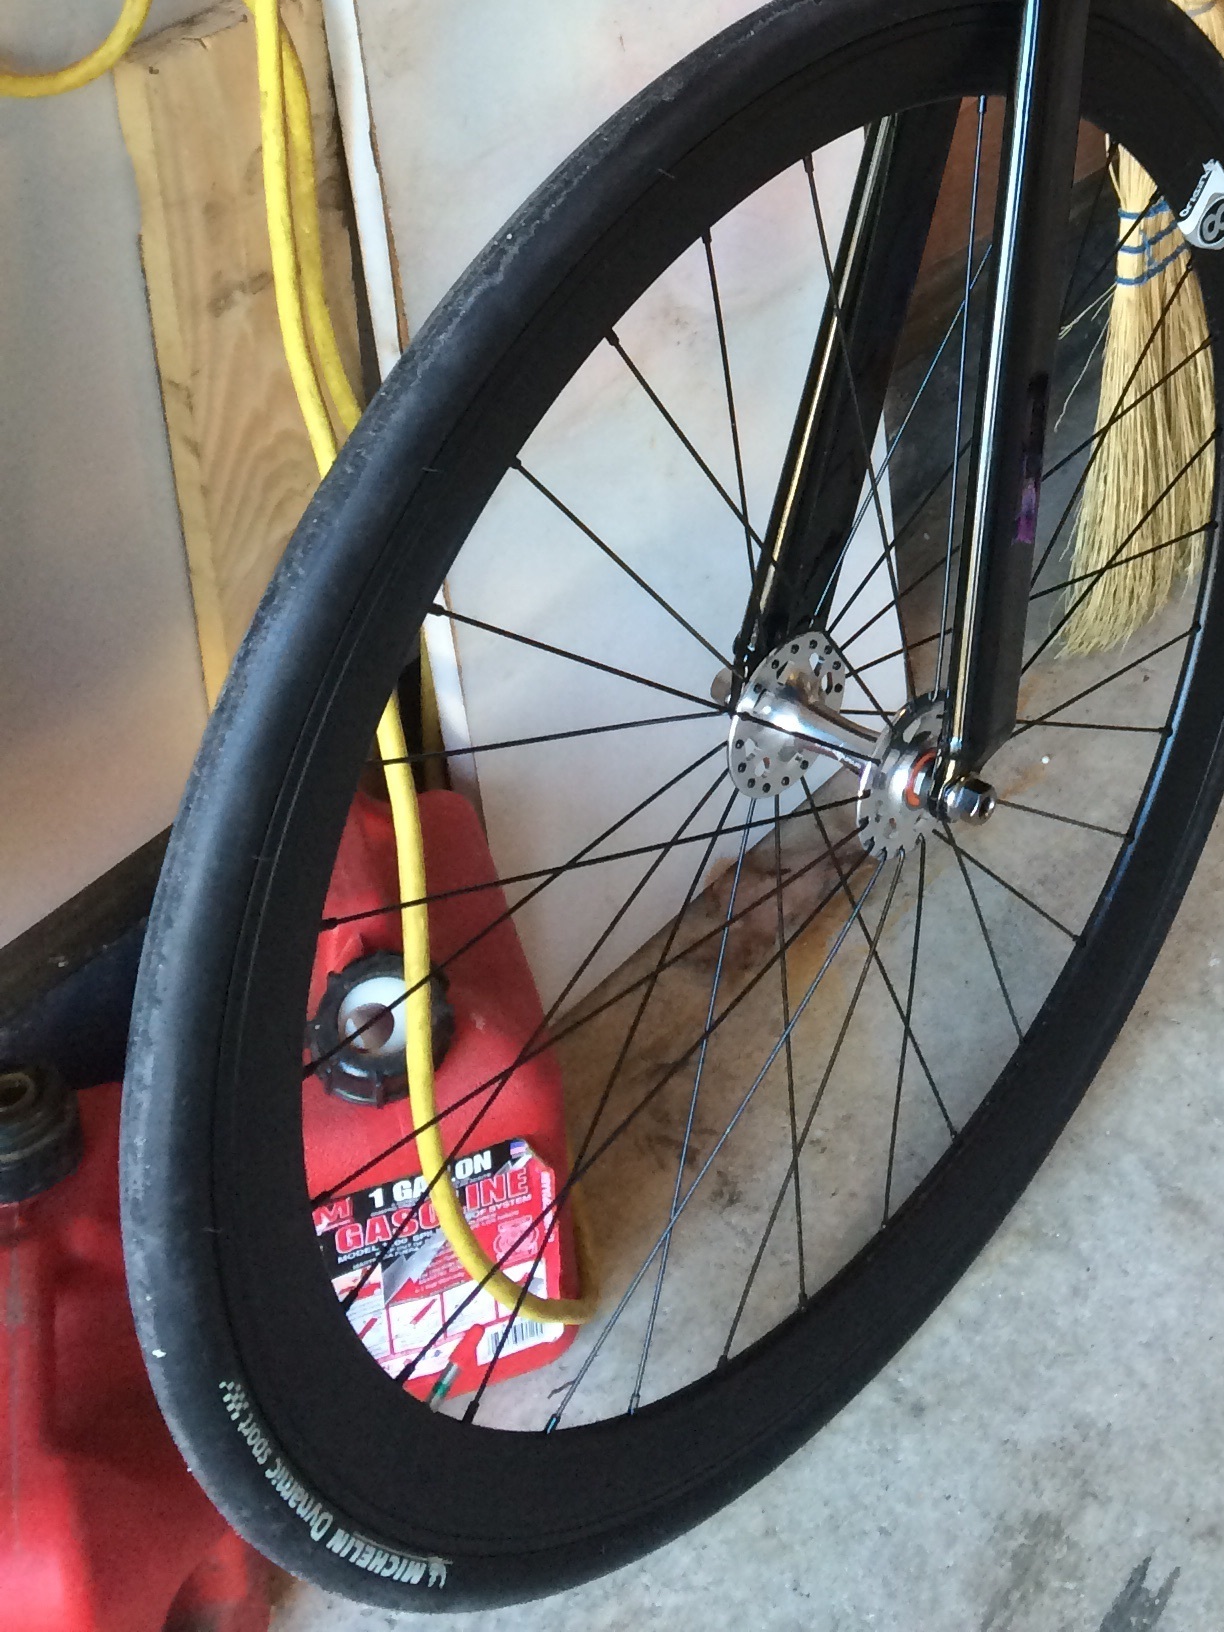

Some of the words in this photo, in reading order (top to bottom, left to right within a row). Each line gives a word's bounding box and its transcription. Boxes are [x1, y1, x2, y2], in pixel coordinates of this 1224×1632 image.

[368, 1187, 384, 1208] 1
[392, 1150, 492, 1203] GAON
[489, 1194, 532, 1213] SYSTEM
[335, 1167, 528, 1254] GASOINE
[337, 1245, 380, 1264] MODEL
[237, 1413, 272, 1465] sport
[265, 1457, 334, 1542] Dynamic
[326, 1528, 427, 1584] MICHELIN
